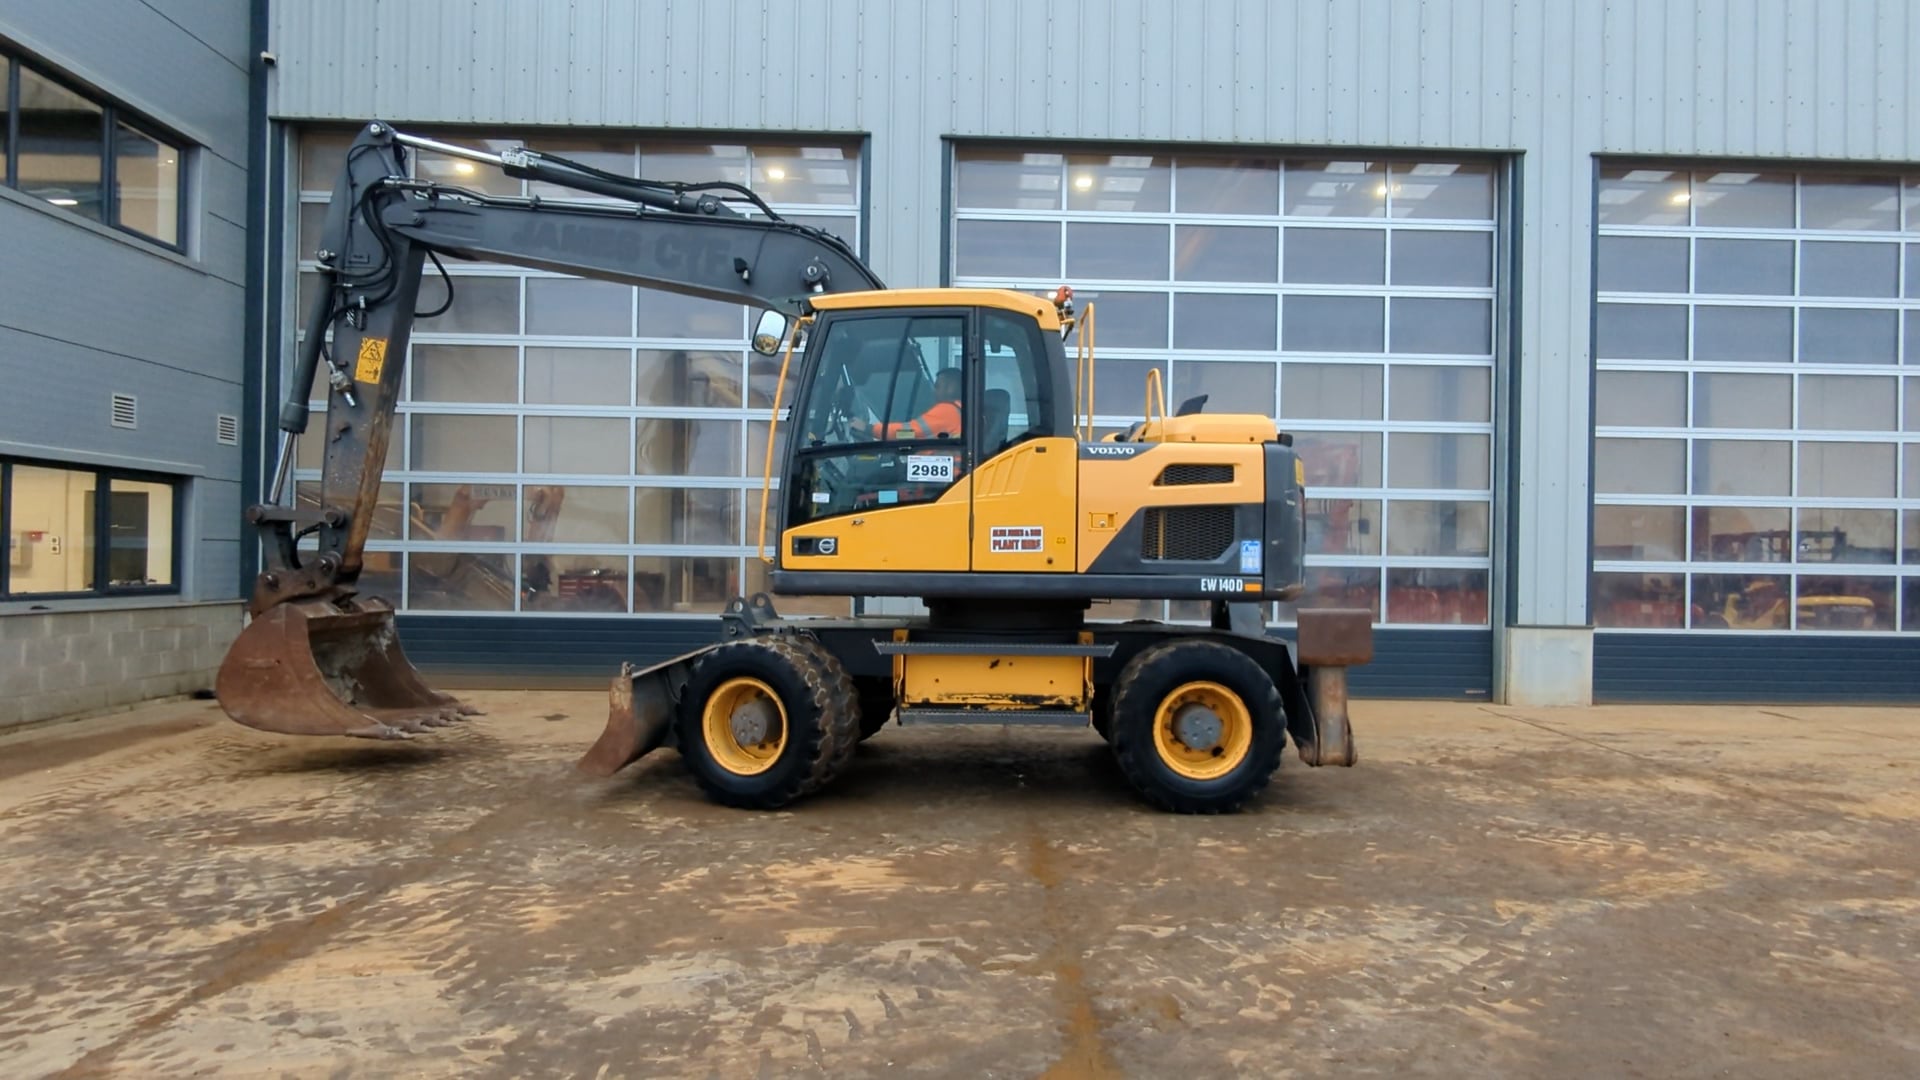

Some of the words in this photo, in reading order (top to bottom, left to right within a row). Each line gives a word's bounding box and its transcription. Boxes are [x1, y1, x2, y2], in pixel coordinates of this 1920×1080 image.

[1087, 446, 1136, 455] VOLVO
[911, 464, 949, 477] 2988
[992, 539, 1020, 550] PLANT
